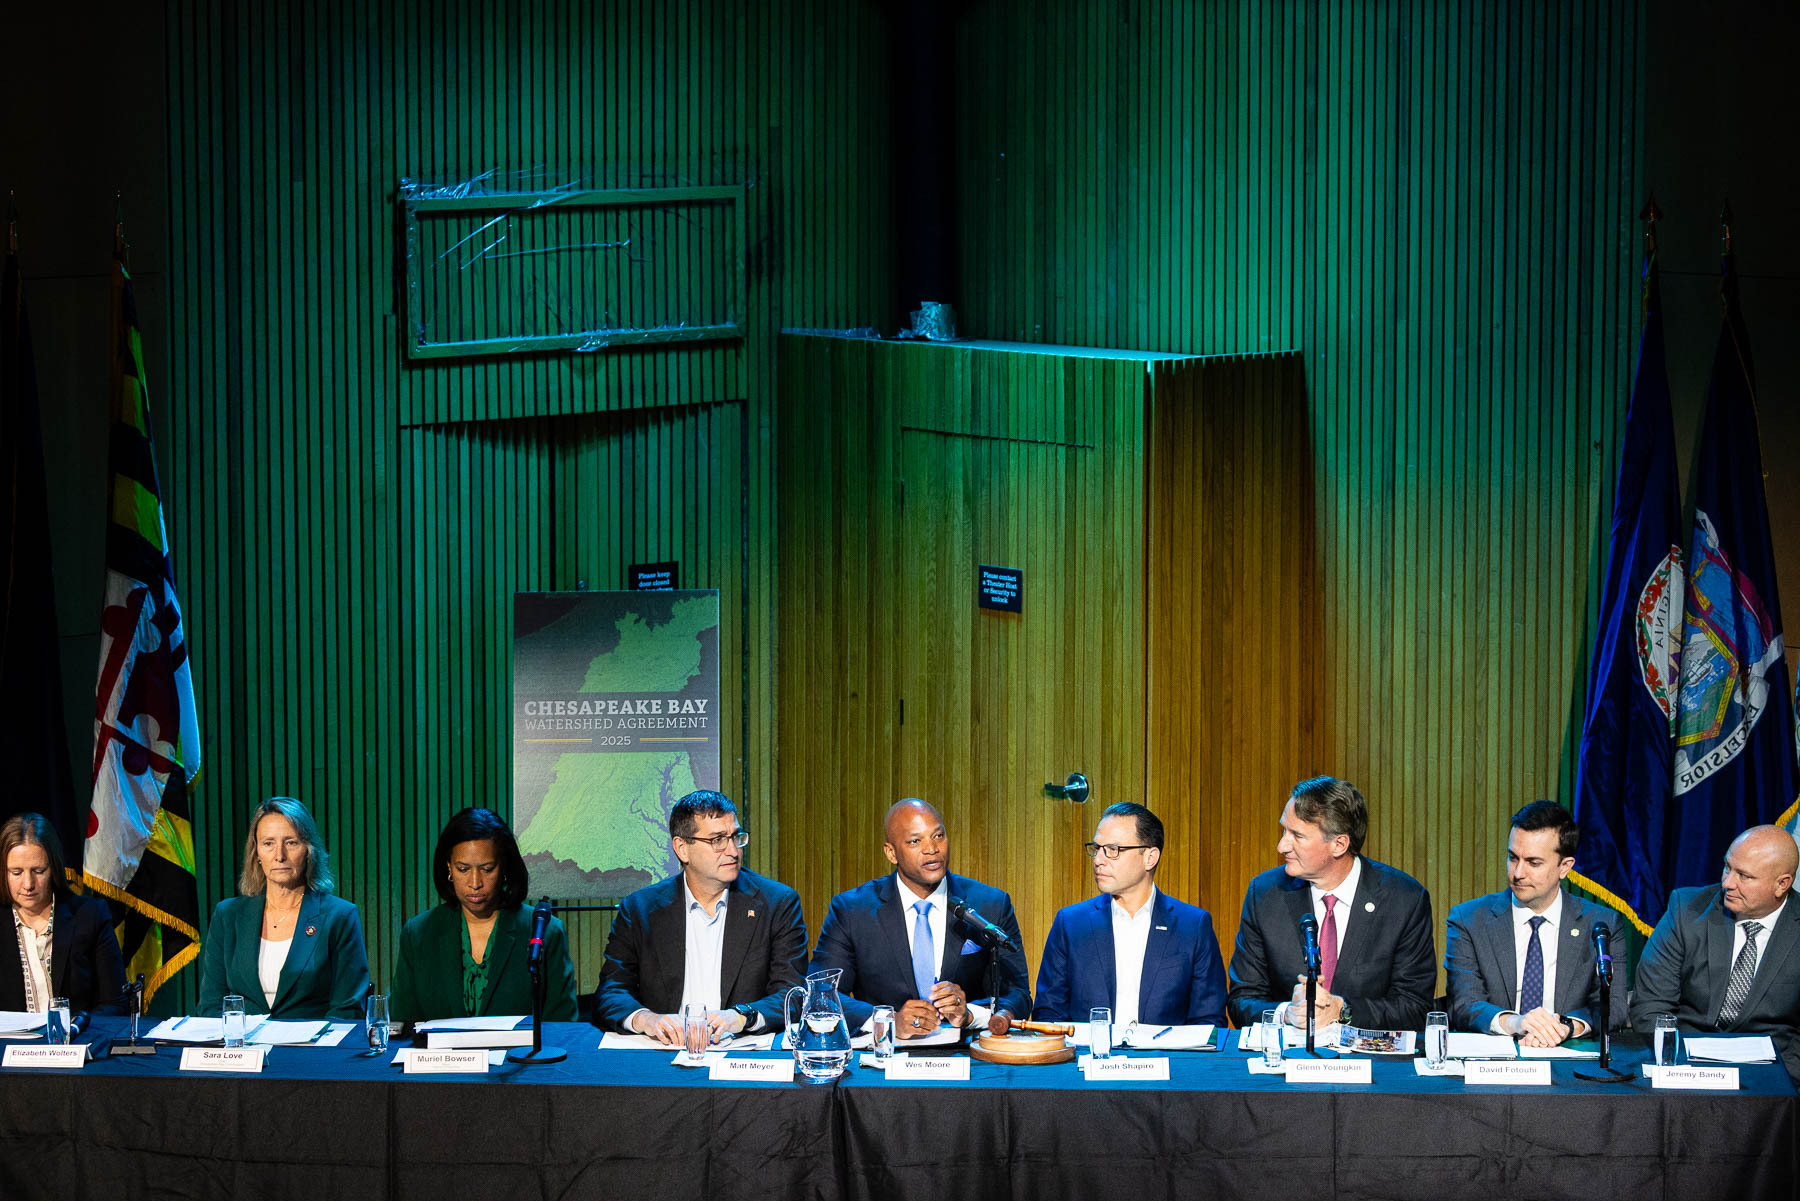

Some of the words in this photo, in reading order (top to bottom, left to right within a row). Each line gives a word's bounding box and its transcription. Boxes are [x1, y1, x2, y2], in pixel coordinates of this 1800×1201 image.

[984, 571, 998, 579] Please
[653, 579, 670, 587] closed
[986, 579, 1005, 588] Theater
[1005, 582, 1017, 590] Host
[990, 588, 1009, 597] Security
[524, 700, 662, 716] CHESAPEAKE
[667, 699, 708, 714] BAY
[524, 718, 613, 730] WATERSHED
[617, 717, 708, 729] AGREEMENT
[601, 736, 631, 746] 2025
[1122, 1063, 1154, 1071] Shapiro
[1296, 1063, 1321, 1071] Glenn
[1323, 1063, 1361, 1073] Youngkin
[1699, 1071, 1726, 1079] Bandy
